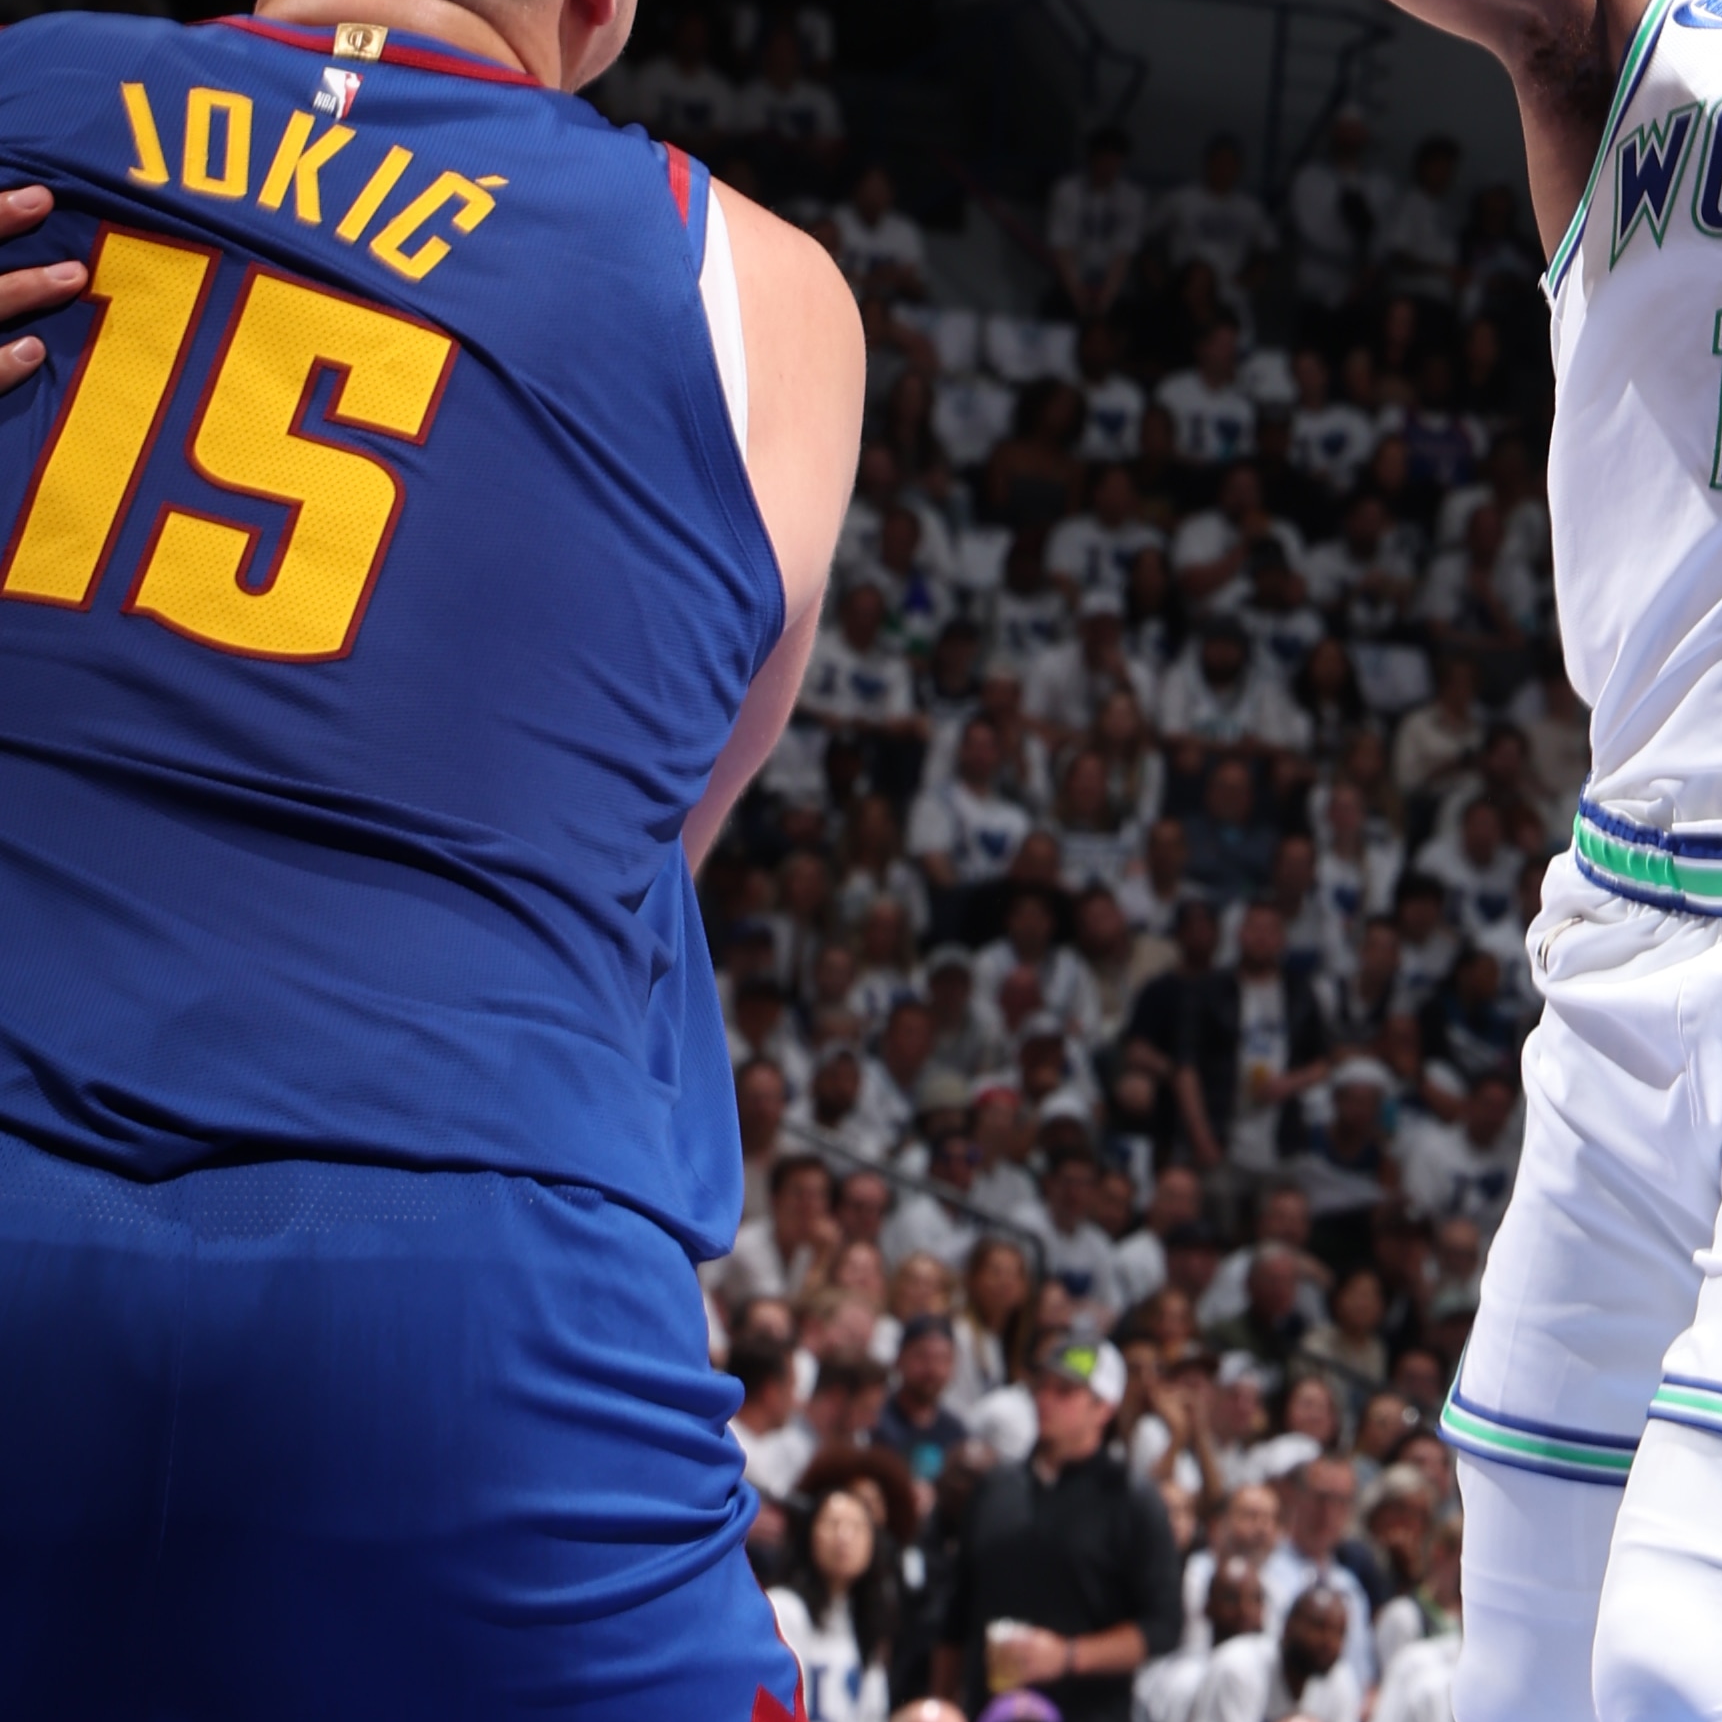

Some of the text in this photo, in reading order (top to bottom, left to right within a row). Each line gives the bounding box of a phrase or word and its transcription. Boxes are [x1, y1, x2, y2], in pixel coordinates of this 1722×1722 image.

[120, 80, 509, 283] JOKIĆ
[312, 90, 338, 115] NBA
[0, 219, 462, 664] 15
